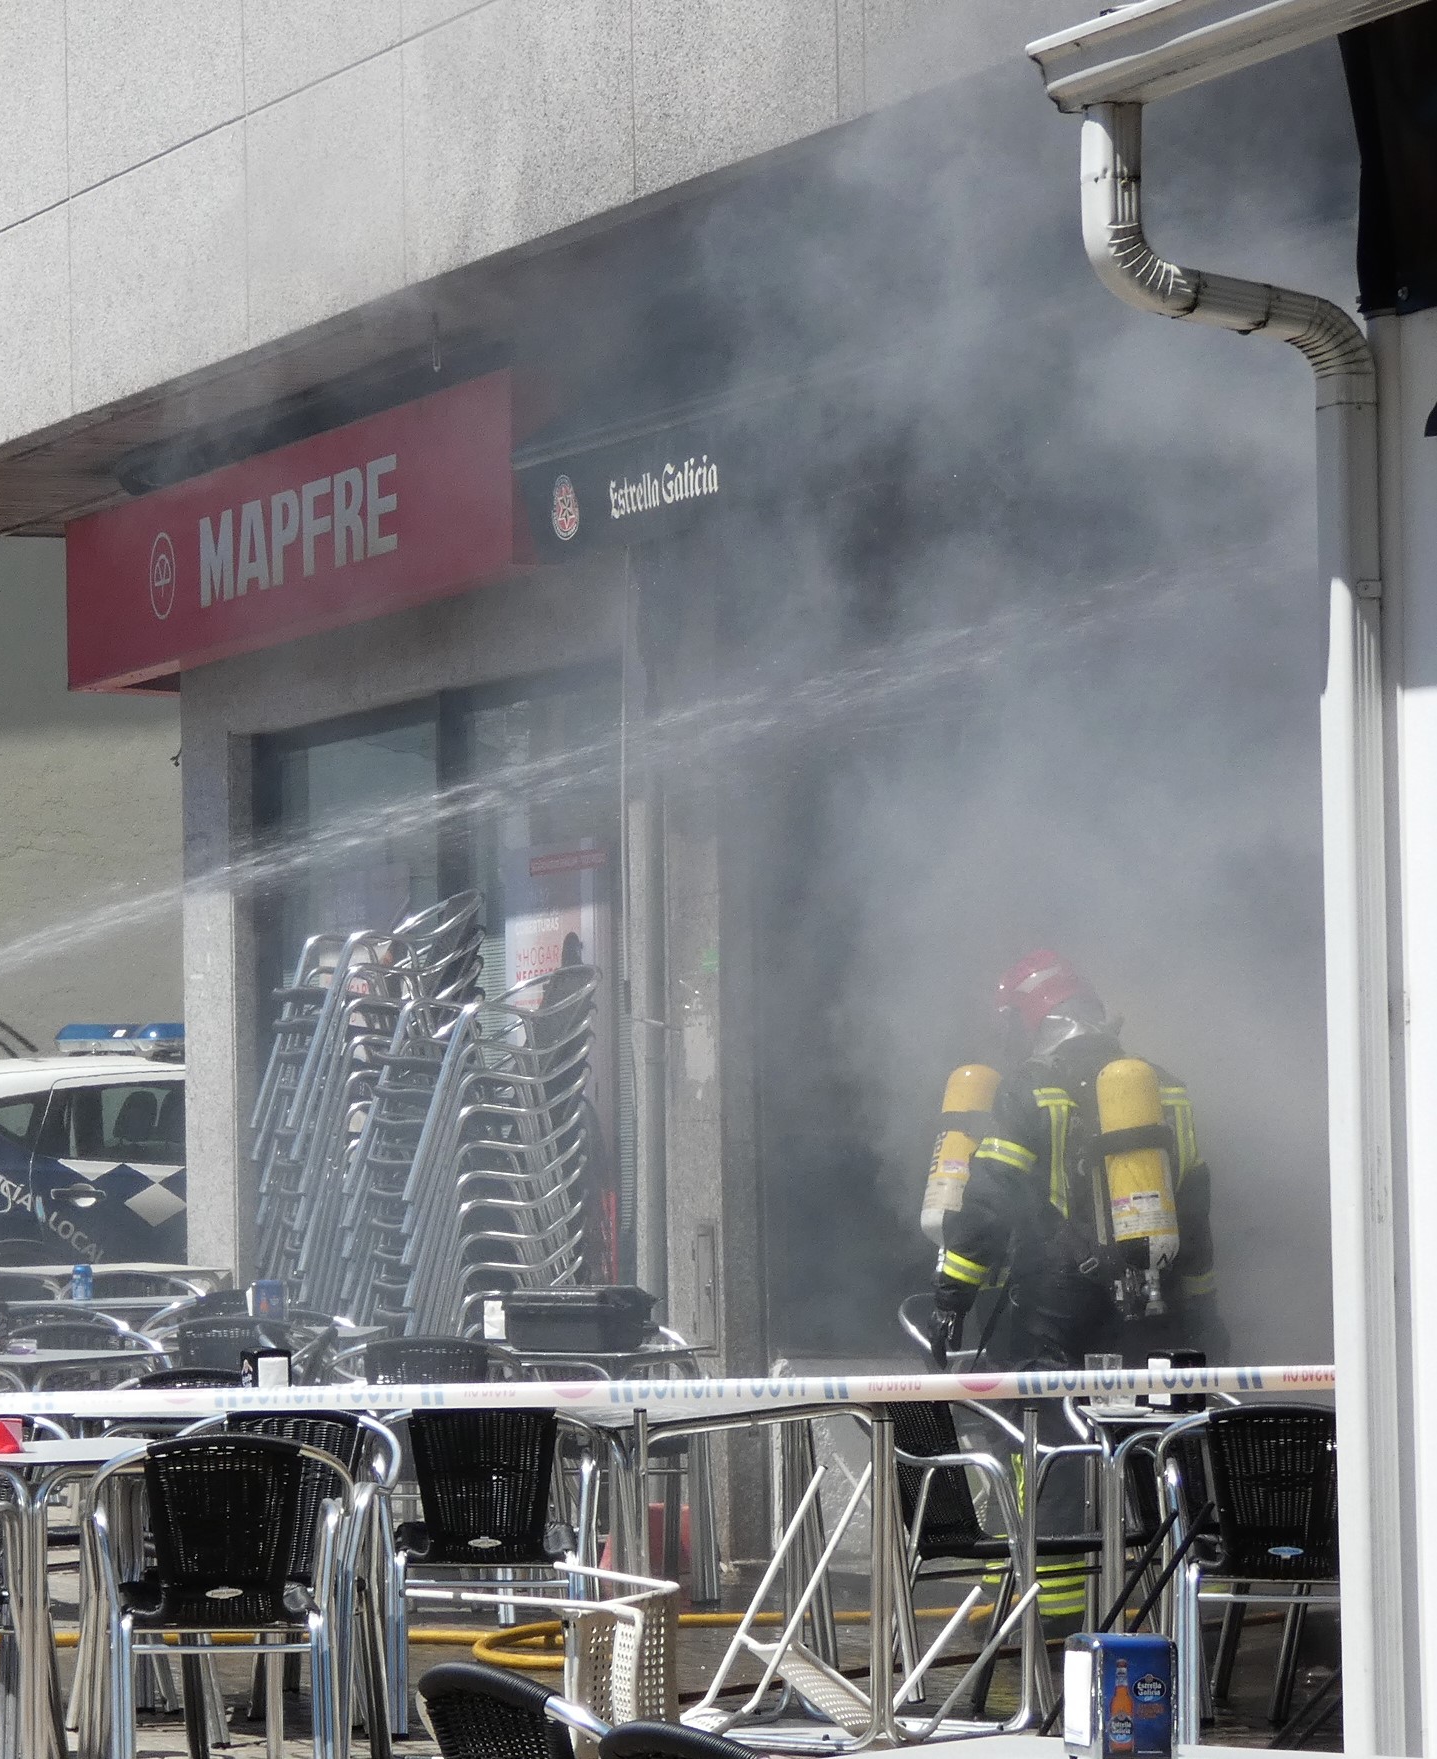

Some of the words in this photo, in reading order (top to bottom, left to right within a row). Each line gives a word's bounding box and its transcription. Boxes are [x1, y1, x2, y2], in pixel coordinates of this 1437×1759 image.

[609, 472, 660, 519] Estrella
[661, 454, 719, 504] Galicia
[198, 452, 399, 609] MAPFRE
[522, 945, 561, 967] HOGAR
